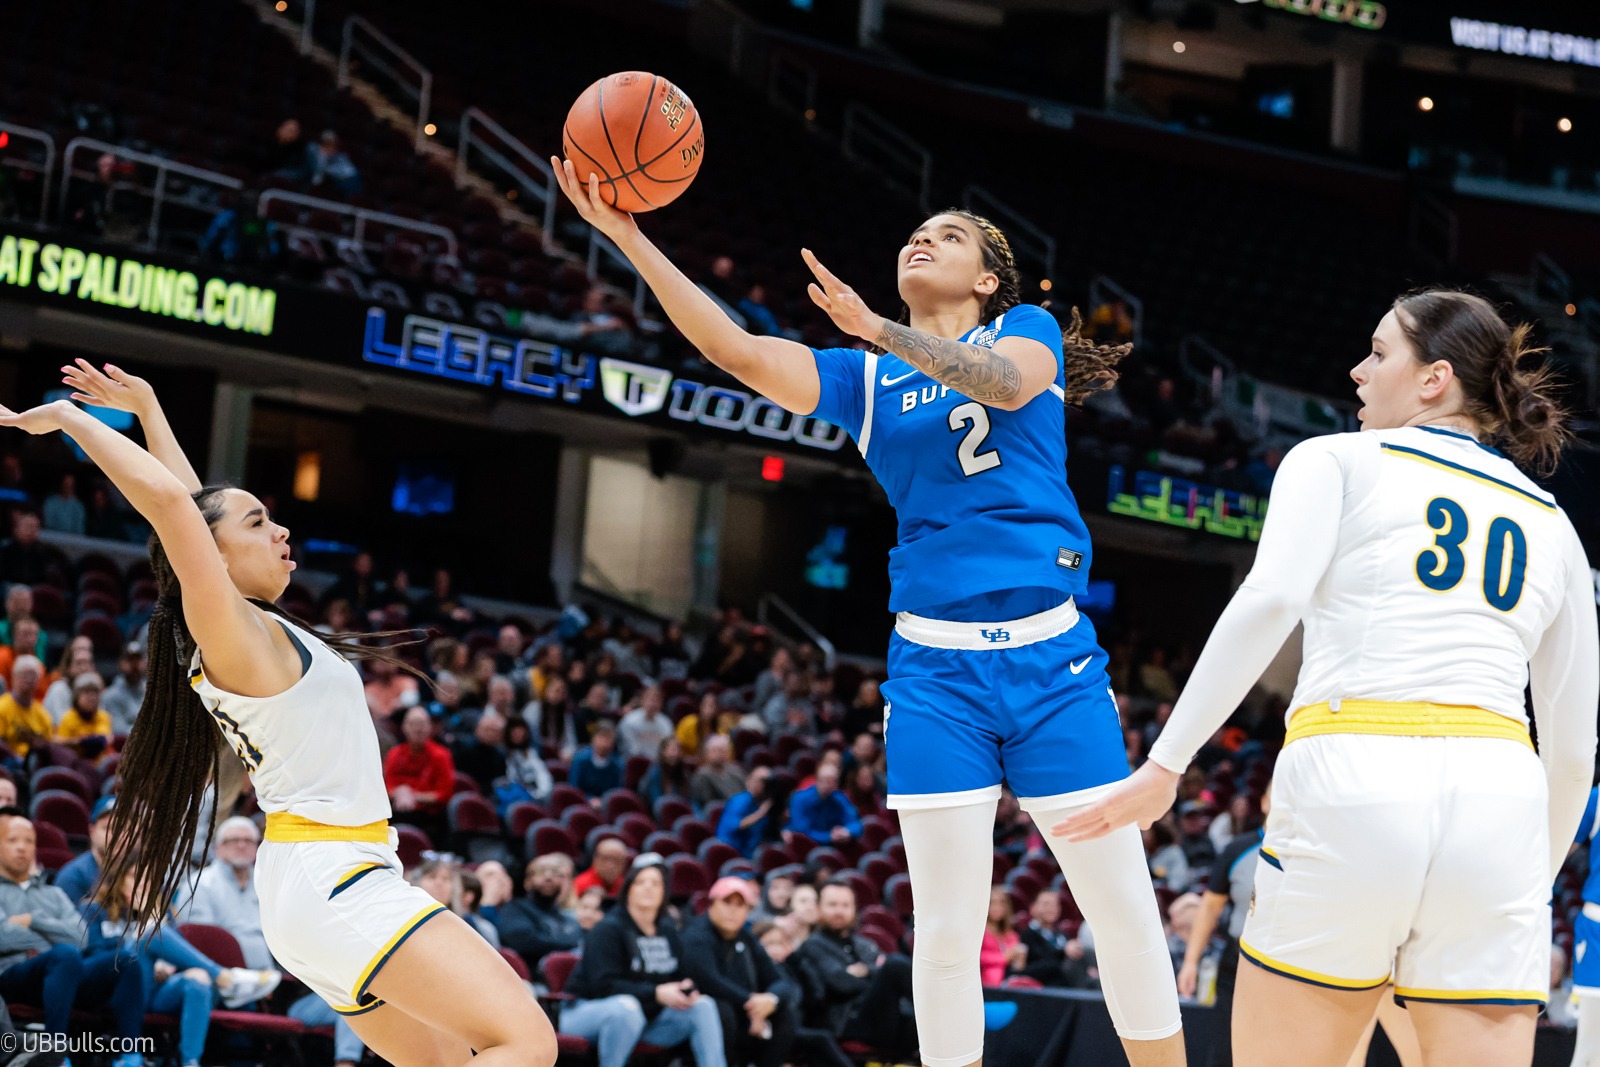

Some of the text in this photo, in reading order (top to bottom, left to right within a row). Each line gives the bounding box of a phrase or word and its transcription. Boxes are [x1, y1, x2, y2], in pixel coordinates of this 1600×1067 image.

[0, 235, 277, 336] AT SPALDING.COM
[362, 306, 597, 403] LEGACY
[900, 383, 951, 414] BUF
[948, 401, 1002, 478] 2
[1412, 494, 1529, 614] 30
[979, 628, 1011, 643] UB
